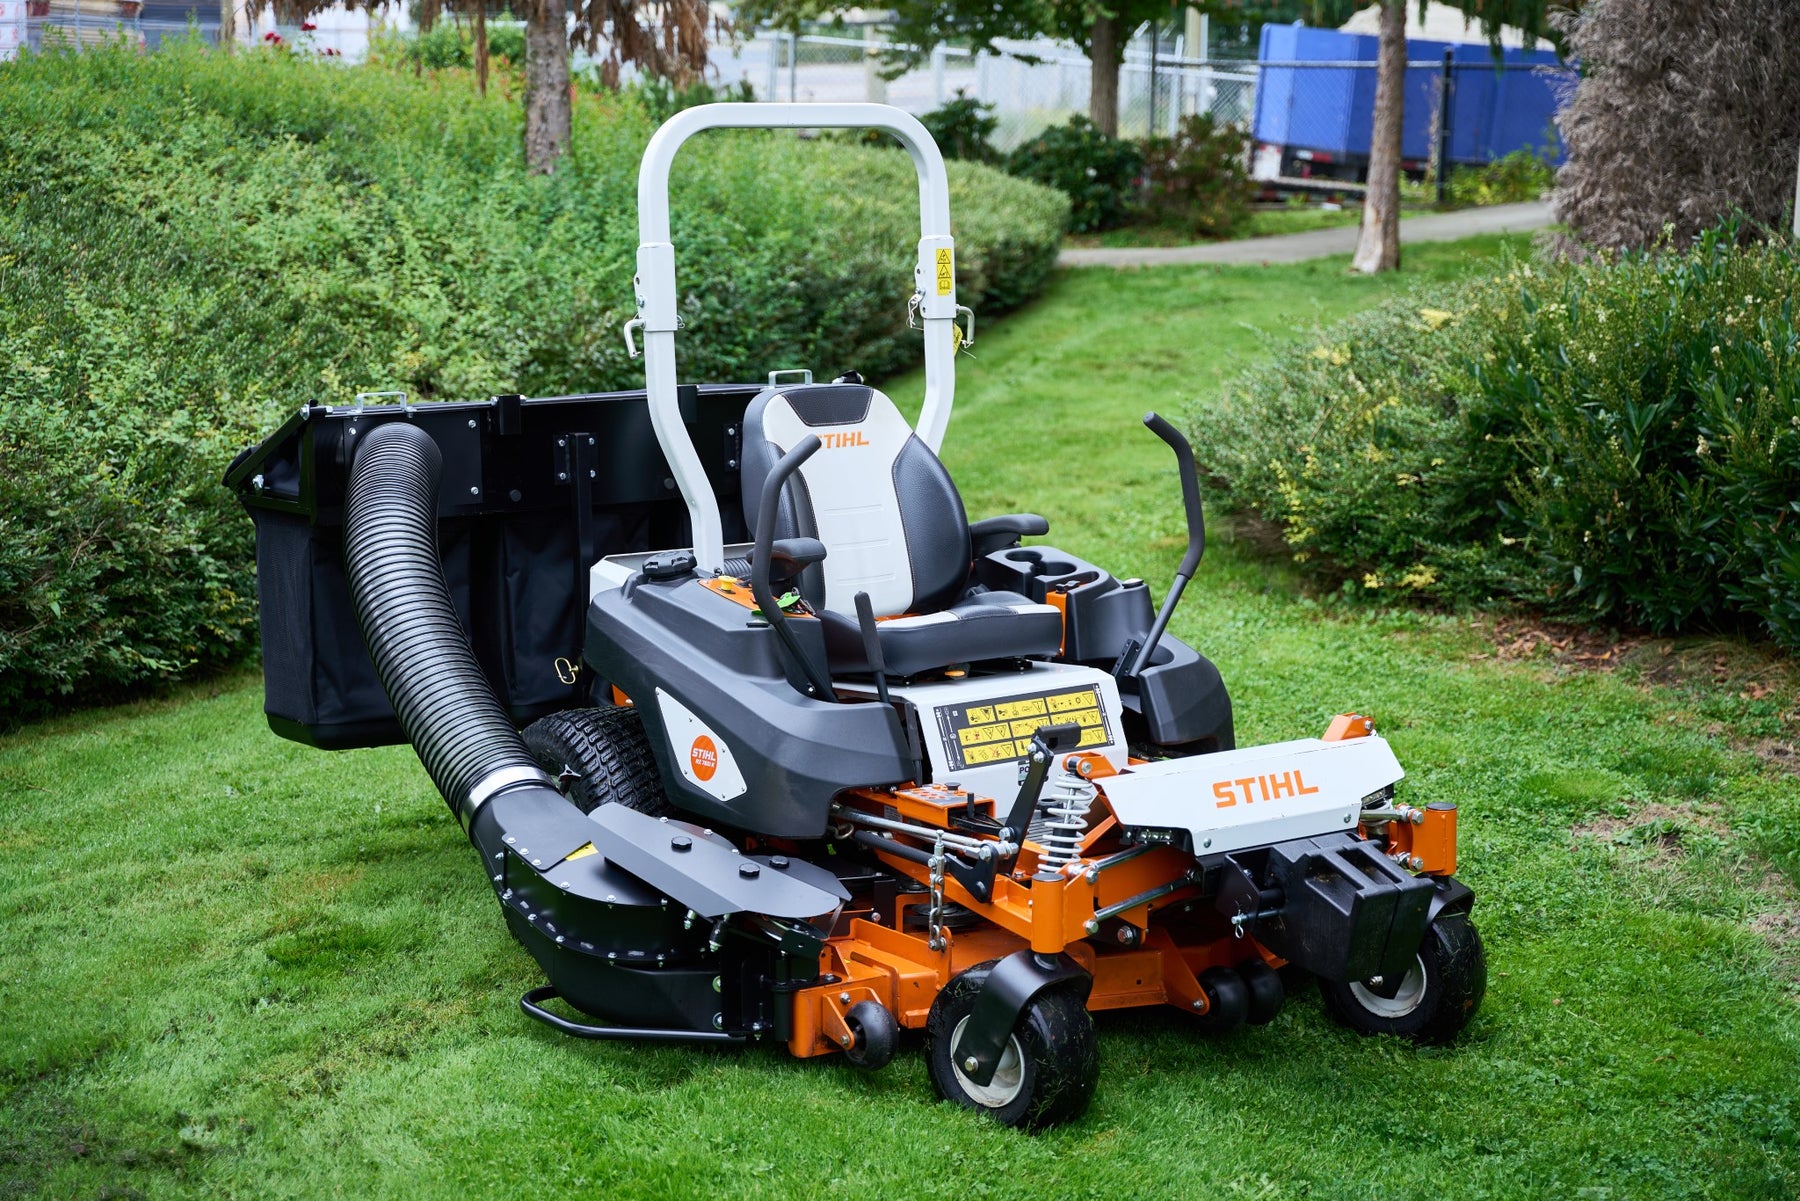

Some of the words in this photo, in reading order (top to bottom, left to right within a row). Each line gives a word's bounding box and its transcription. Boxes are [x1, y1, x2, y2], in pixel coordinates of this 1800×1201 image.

[817, 431, 870, 449] TIHL
[692, 747, 716, 761] STIHL
[1212, 769, 1320, 809] STIHL
